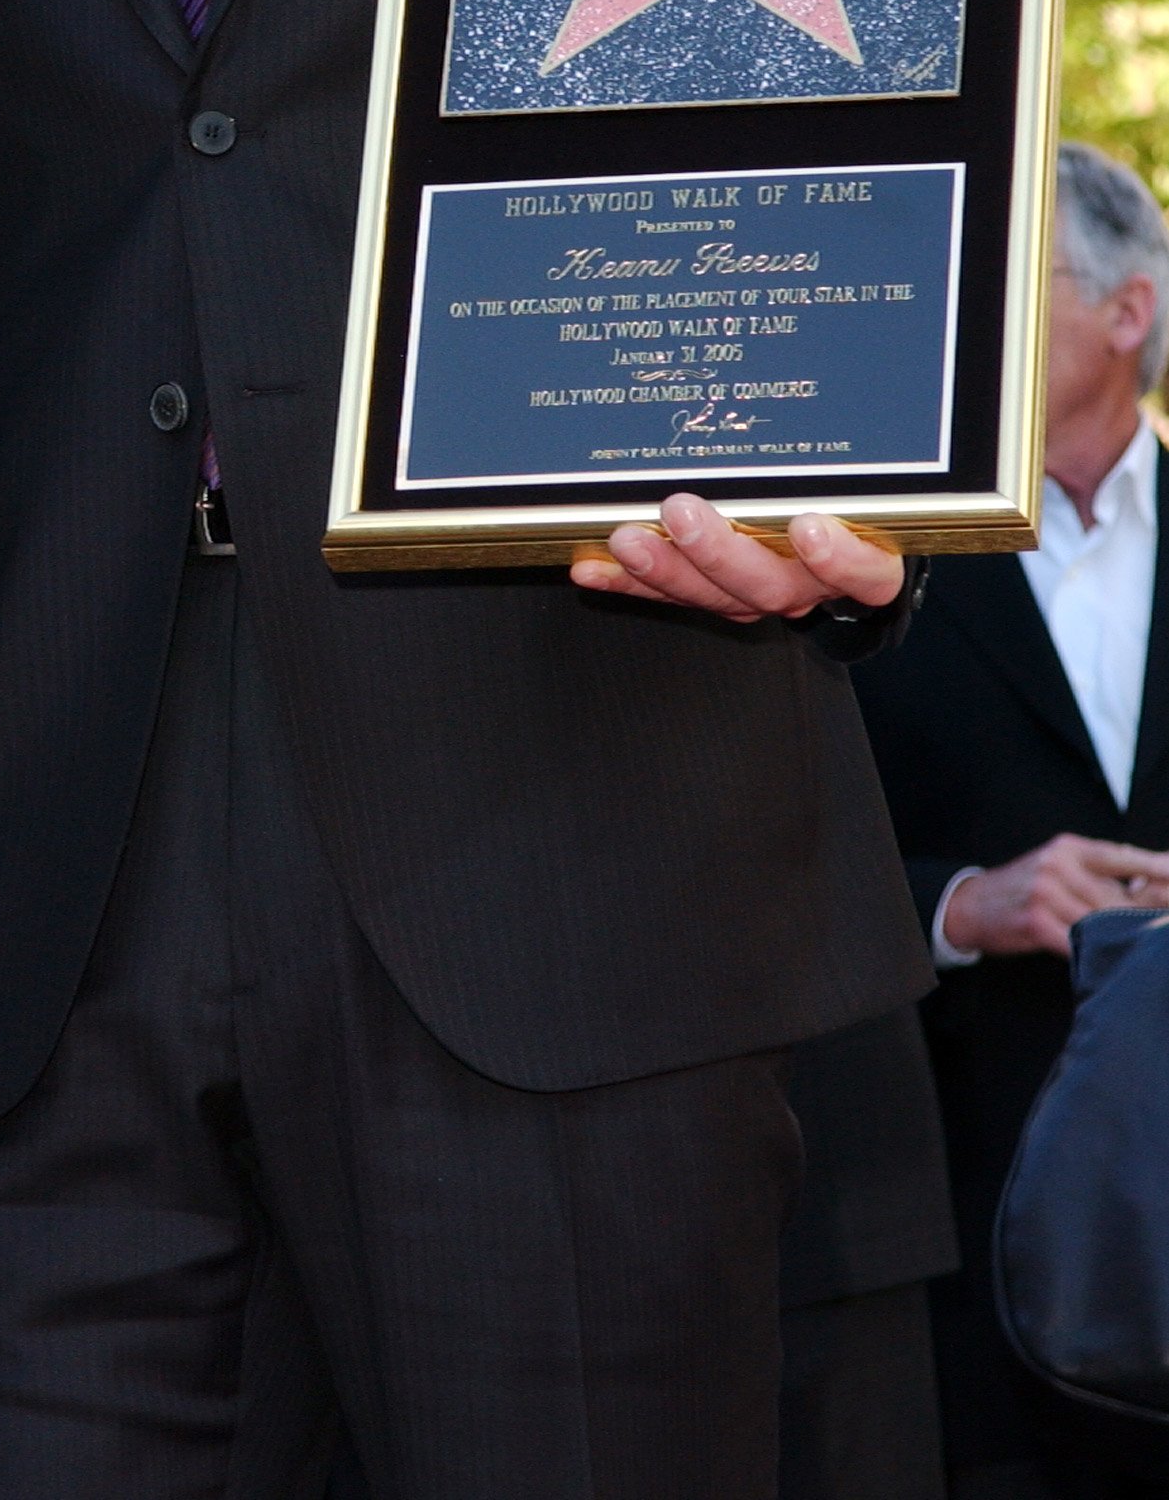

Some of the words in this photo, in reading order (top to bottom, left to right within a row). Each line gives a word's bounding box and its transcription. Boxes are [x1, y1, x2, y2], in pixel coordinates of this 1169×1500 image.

[505, 190, 654, 217] HOLLYWOOD
[671, 186, 742, 208] WALK
[758, 184, 789, 205] OF
[804, 181, 873, 203] FAME
[718, 219, 736, 231] TO
[547, 247, 682, 281] Keanu
[690, 242, 820, 275] Reeves
[450, 302, 472, 318] ON
[477, 300, 507, 317] THE
[510, 296, 582, 315] OCCASION
[587, 295, 607, 311] OF
[612, 294, 641, 310] THE
[646, 290, 737, 310] PLACEMENT
[741, 289, 761, 305] OF
[767, 287, 812, 304] YOUR
[814, 286, 857, 303] STAR
[861, 285, 880, 301] IN
[884, 284, 915, 300] THE
[559, 321, 663, 341] HOLLYWOOD
[668, 317, 719, 337] WALK
[723, 316, 746, 335] OF
[750, 315, 799, 334] FAME
[702, 343, 744, 362] 2005
[530, 388, 626, 407] HOLLYWOOD
[629, 384, 706, 402] CHAMBER
[708, 383, 730, 400] OF
[733, 380, 819, 399] COMMERCE
[641, 447, 683, 457] GRANT
[688, 445, 754, 456] CHAIRMAN
[758, 443, 795, 453] WALK
[797, 442, 813, 453] OF
[816, 441, 853, 452] FAME
